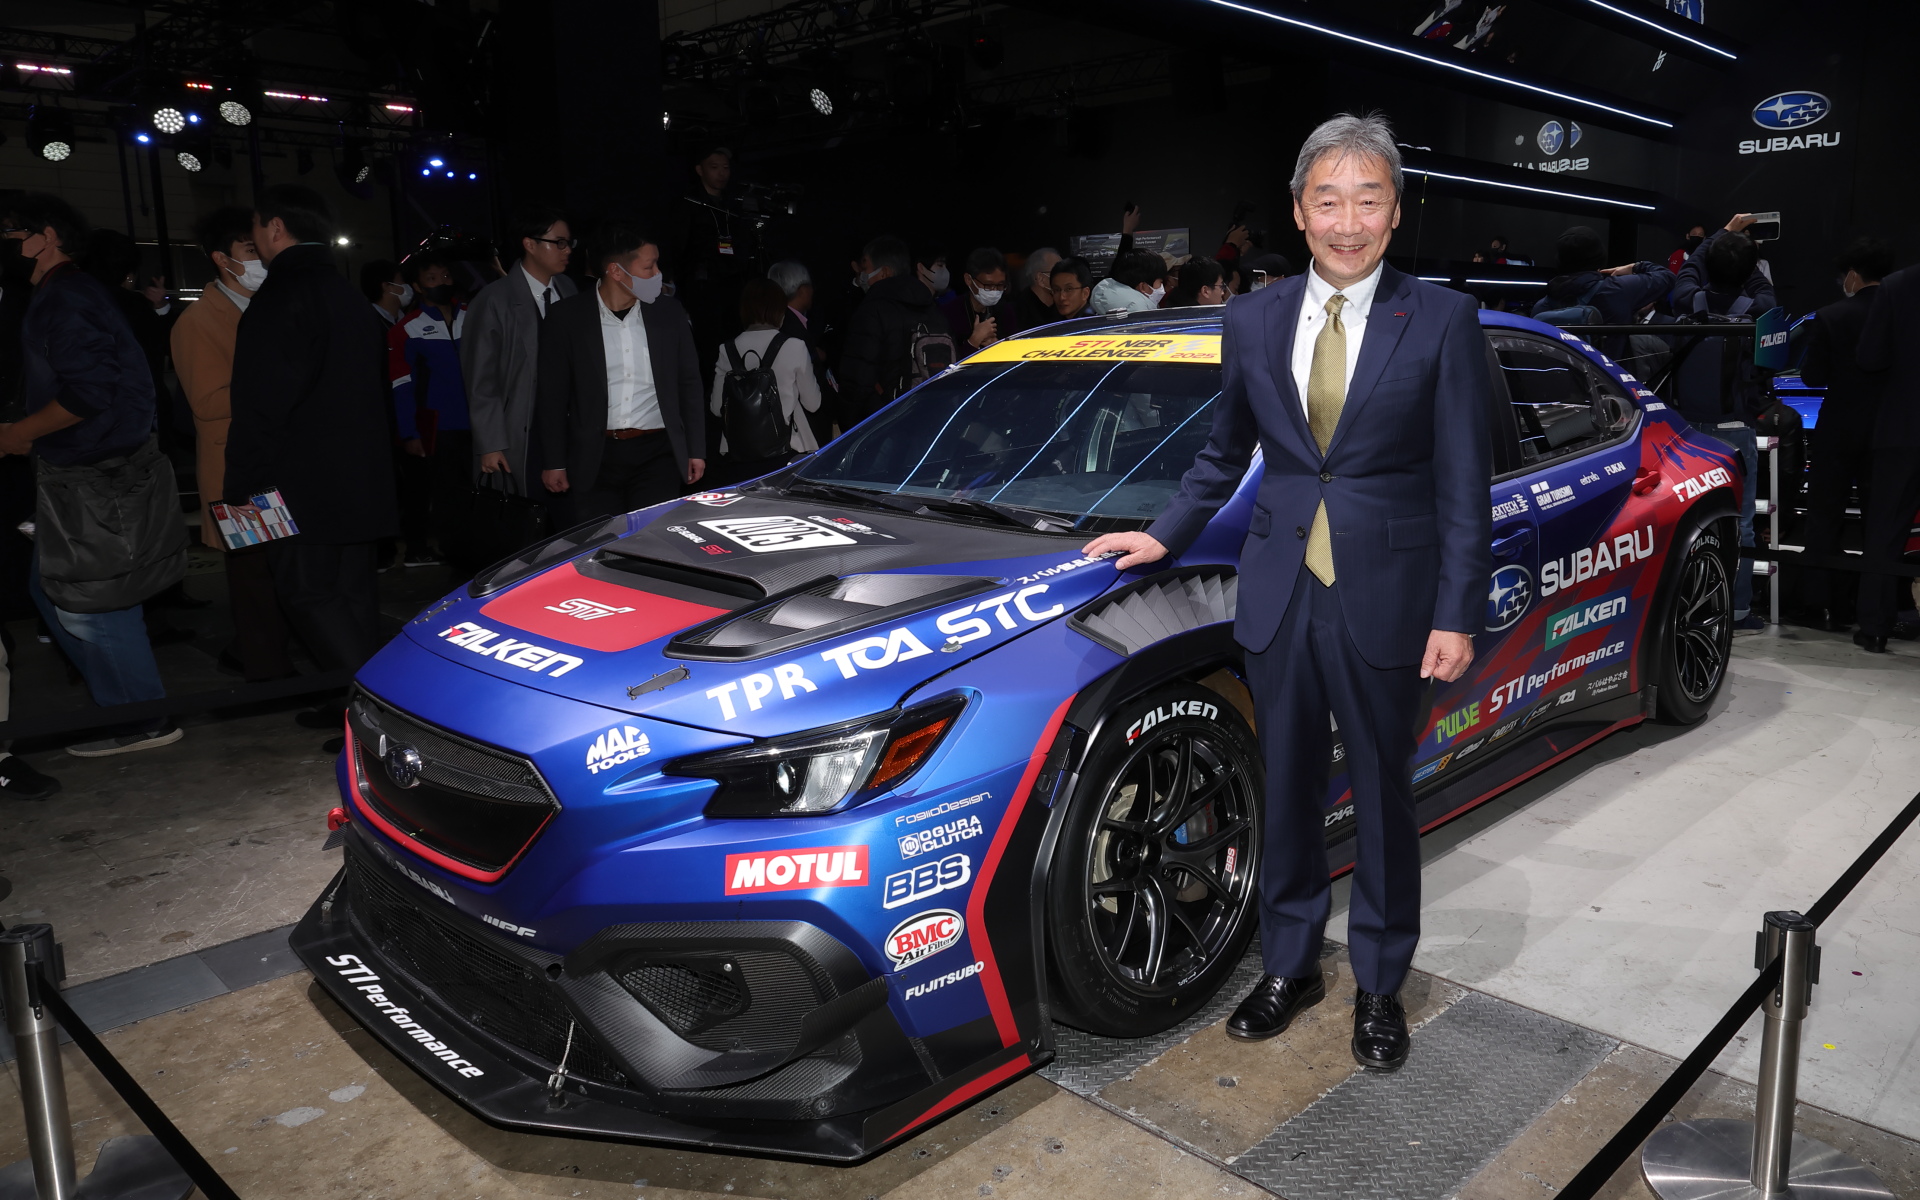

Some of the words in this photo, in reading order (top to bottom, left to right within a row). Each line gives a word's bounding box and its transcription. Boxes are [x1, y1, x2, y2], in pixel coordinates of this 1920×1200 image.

[1738, 131, 1841, 154] SUBARU
[1021, 349, 1157, 359] CHALLENGE
[1069, 340, 1112, 349] STI
[1115, 340, 1174, 349] NBR
[1760, 331, 1787, 348] FALKEN
[1535, 491, 1552, 507] GRAN
[1549, 485, 1574, 502] TURISMO
[1672, 466, 1732, 502] FALKEN
[1541, 524, 1655, 597] SUBARU
[1690, 535, 1721, 557] FALKEN
[1551, 595, 1628, 641] FALKEN
[437, 621, 584, 677] FALKEN
[705, 662, 819, 721] TPR
[819, 626, 935, 679] TOA
[935, 583, 1065, 646] STC
[1489, 673, 1526, 714] STI
[1526, 641, 1625, 694] Performance
[1125, 700, 1219, 747] FALKEN
[1436, 700, 1480, 744] PULSE
[586, 725, 650, 766] MAC
[587, 744, 652, 775] TOOLS
[919, 815, 981, 842] OGURA
[921, 824, 984, 852] CLUTCH
[731, 850, 863, 890] MOTUL
[1225, 847, 1236, 875] BBS
[395, 860, 456, 906] SUBARU
[883, 853, 971, 910] BBS
[894, 917, 955, 956] BMC
[898, 946, 927, 967] Air
[926, 937, 951, 954] Filter
[904, 960, 985, 1001] FUJITSUBO
[325, 953, 382, 985] STI
[356, 983, 485, 1079] Performance
